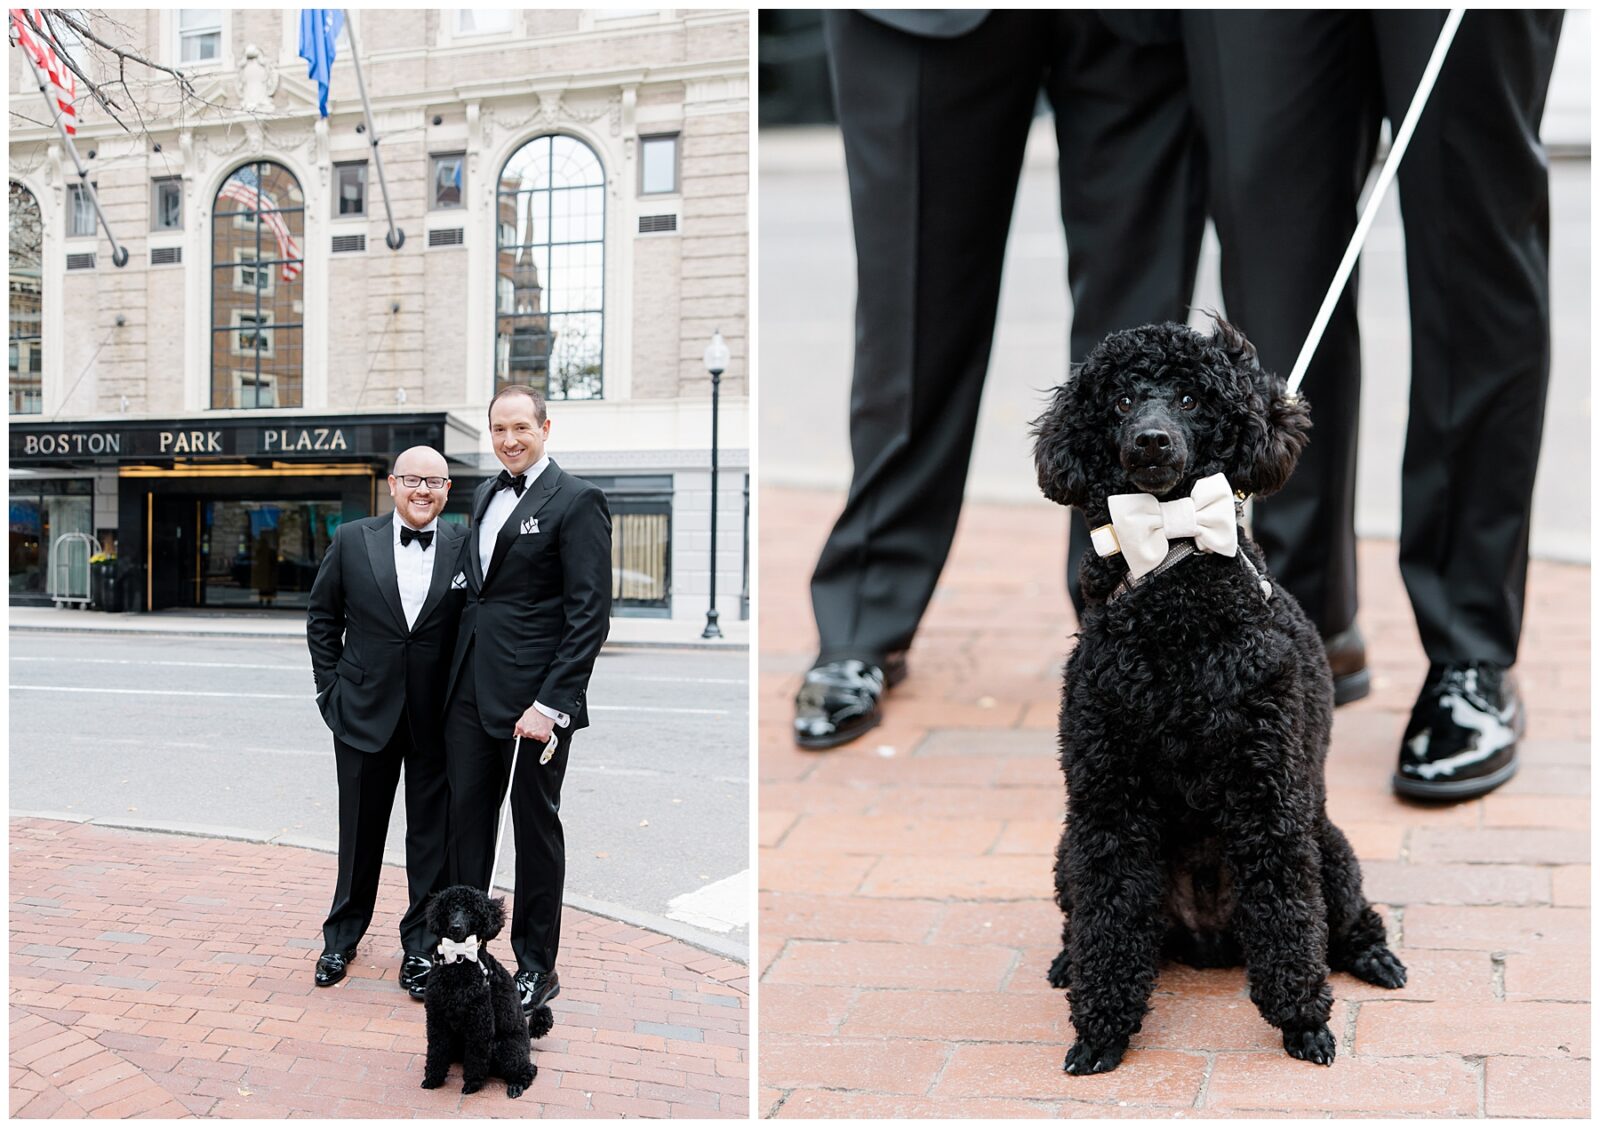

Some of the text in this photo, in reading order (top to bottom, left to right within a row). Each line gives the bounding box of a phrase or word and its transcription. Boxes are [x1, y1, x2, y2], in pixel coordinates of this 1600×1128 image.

[24, 428, 348, 455] BOSTON PARK PLAZA
